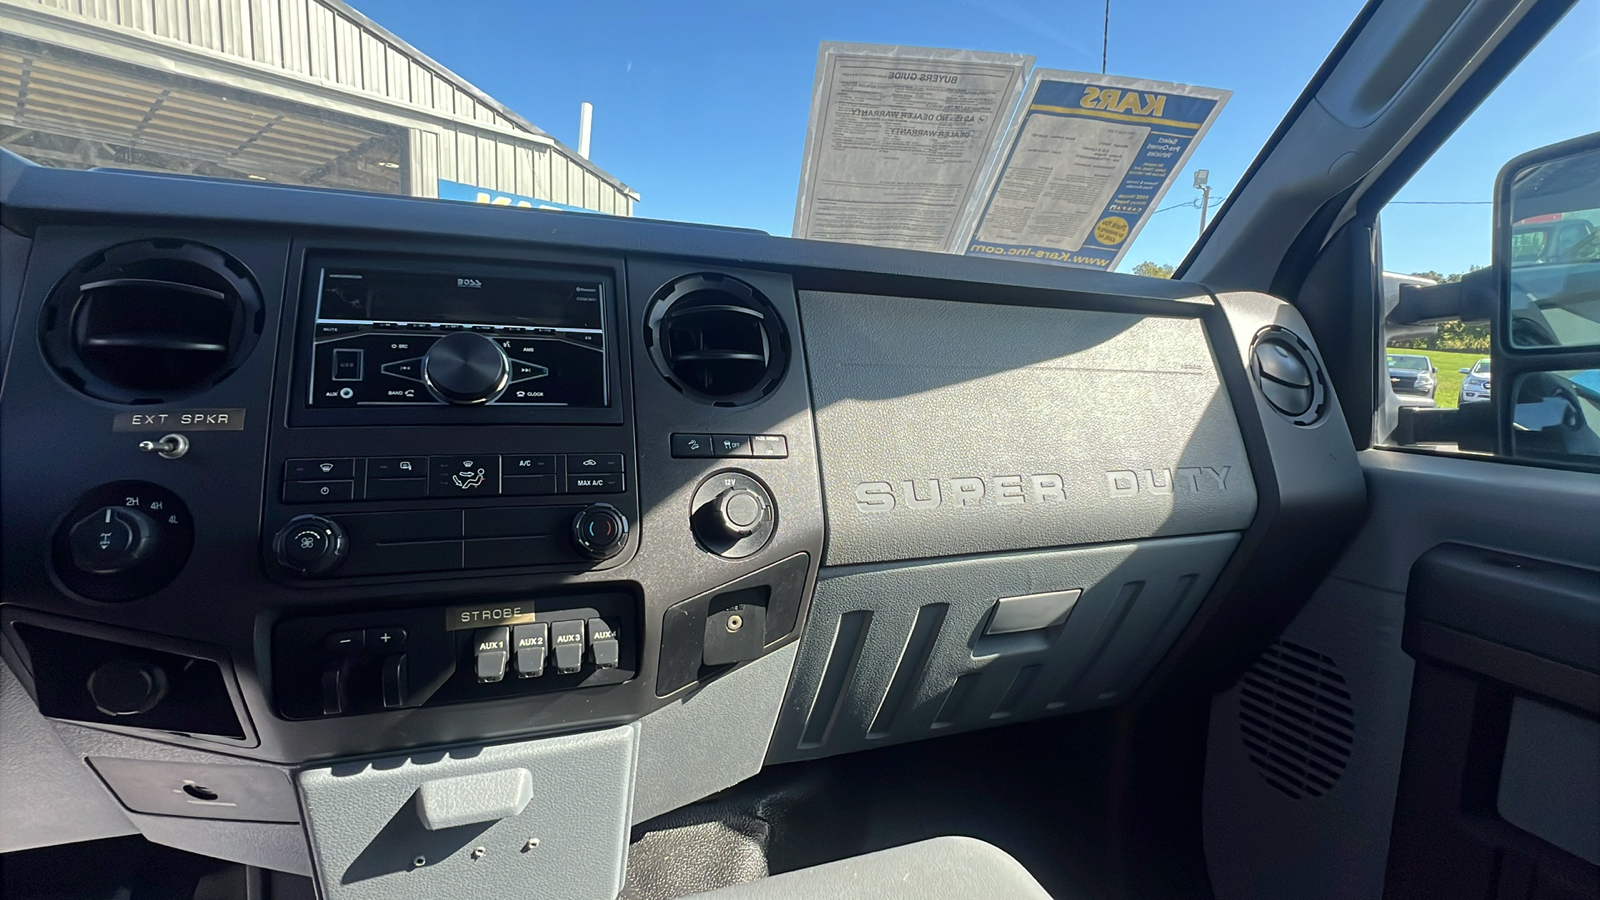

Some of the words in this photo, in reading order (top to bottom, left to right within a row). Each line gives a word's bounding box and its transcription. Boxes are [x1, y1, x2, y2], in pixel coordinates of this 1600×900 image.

[457, 278, 482, 287] BOSS
[132, 414, 168, 425] EXT
[181, 413, 229, 424] SPKR
[519, 459, 531, 467] A/C
[591, 479, 603, 487] A/C
[724, 478, 736, 486] 12V
[856, 473, 1068, 514] SUPER
[1106, 465, 1233, 499] DUTY
[126, 498, 139, 506] 2H
[150, 501, 163, 510] 4H
[168, 515, 178, 524] 4L
[460, 607, 523, 622] STROBE
[557, 633, 573, 642] AUX
[574, 633, 581, 642] 3
[593, 631, 611, 640] AUX
[519, 637, 537, 647] AUX
[537, 636, 544, 646] 2
[479, 642, 498, 651] AUX
